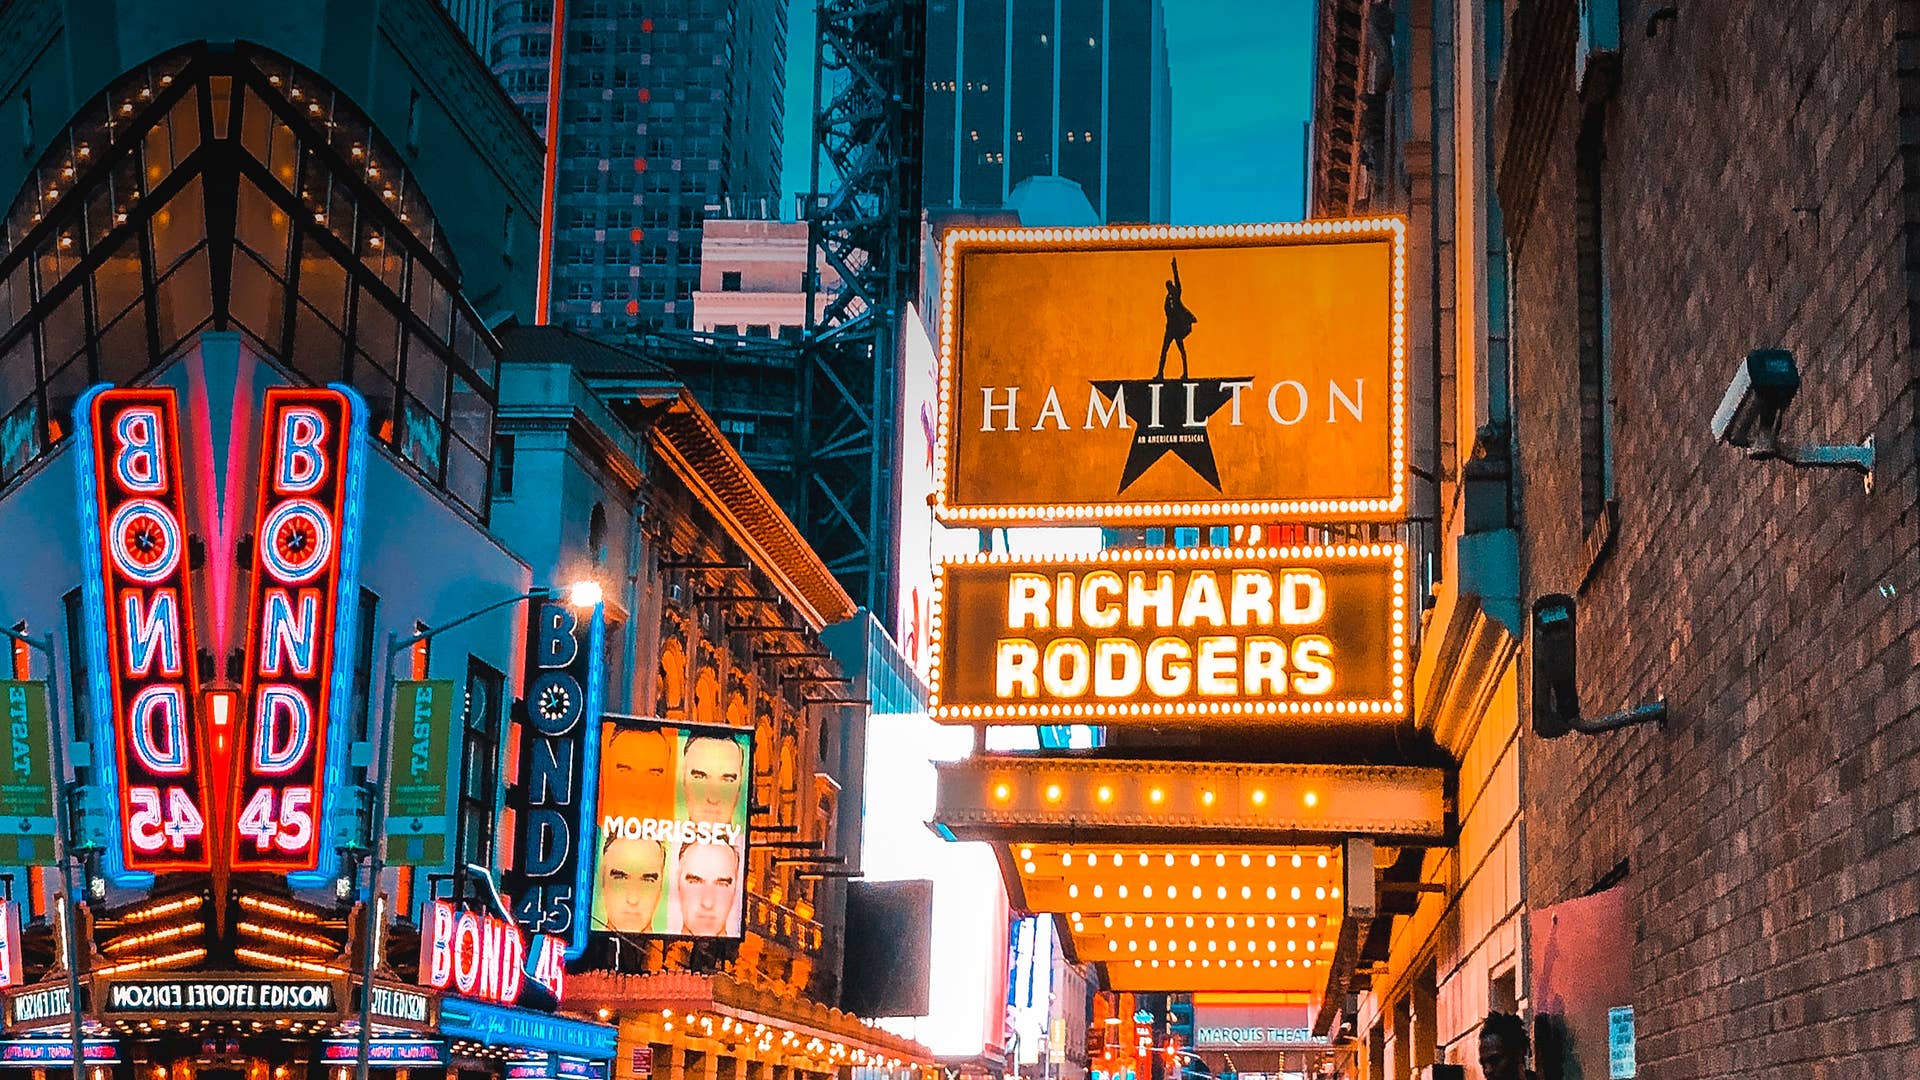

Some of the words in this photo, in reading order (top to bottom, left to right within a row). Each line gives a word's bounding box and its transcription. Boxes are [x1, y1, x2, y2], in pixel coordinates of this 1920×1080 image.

[979, 378, 1366, 432] HAMILTON
[1137, 435, 1146, 444] AN
[1147, 434, 1178, 444] AMERICAN
[1179, 433, 1205, 443] MUSICAL
[252, 406, 334, 774] BOND
[1007, 567, 1327, 629] RICHARD
[995, 634, 1337, 699] RODGERS
[411, 685, 433, 776] TASTE
[526, 603, 584, 878] BOND
[238, 786, 314, 852] 45
[602, 815, 742, 846] MORRISSEY
[519, 883, 572, 934] 45
[431, 901, 524, 1005] BOND
[536, 935, 566, 1001] 45
[260, 985, 330, 1007] EDISON
[392, 991, 427, 1021] EDISON
[511, 1018, 546, 1041] ITALIAN
[548, 1022, 584, 1046] KITCHEN
[1198, 1027, 1265, 1046] MARQUIS
[1266, 1027, 1329, 1044] THEAT
